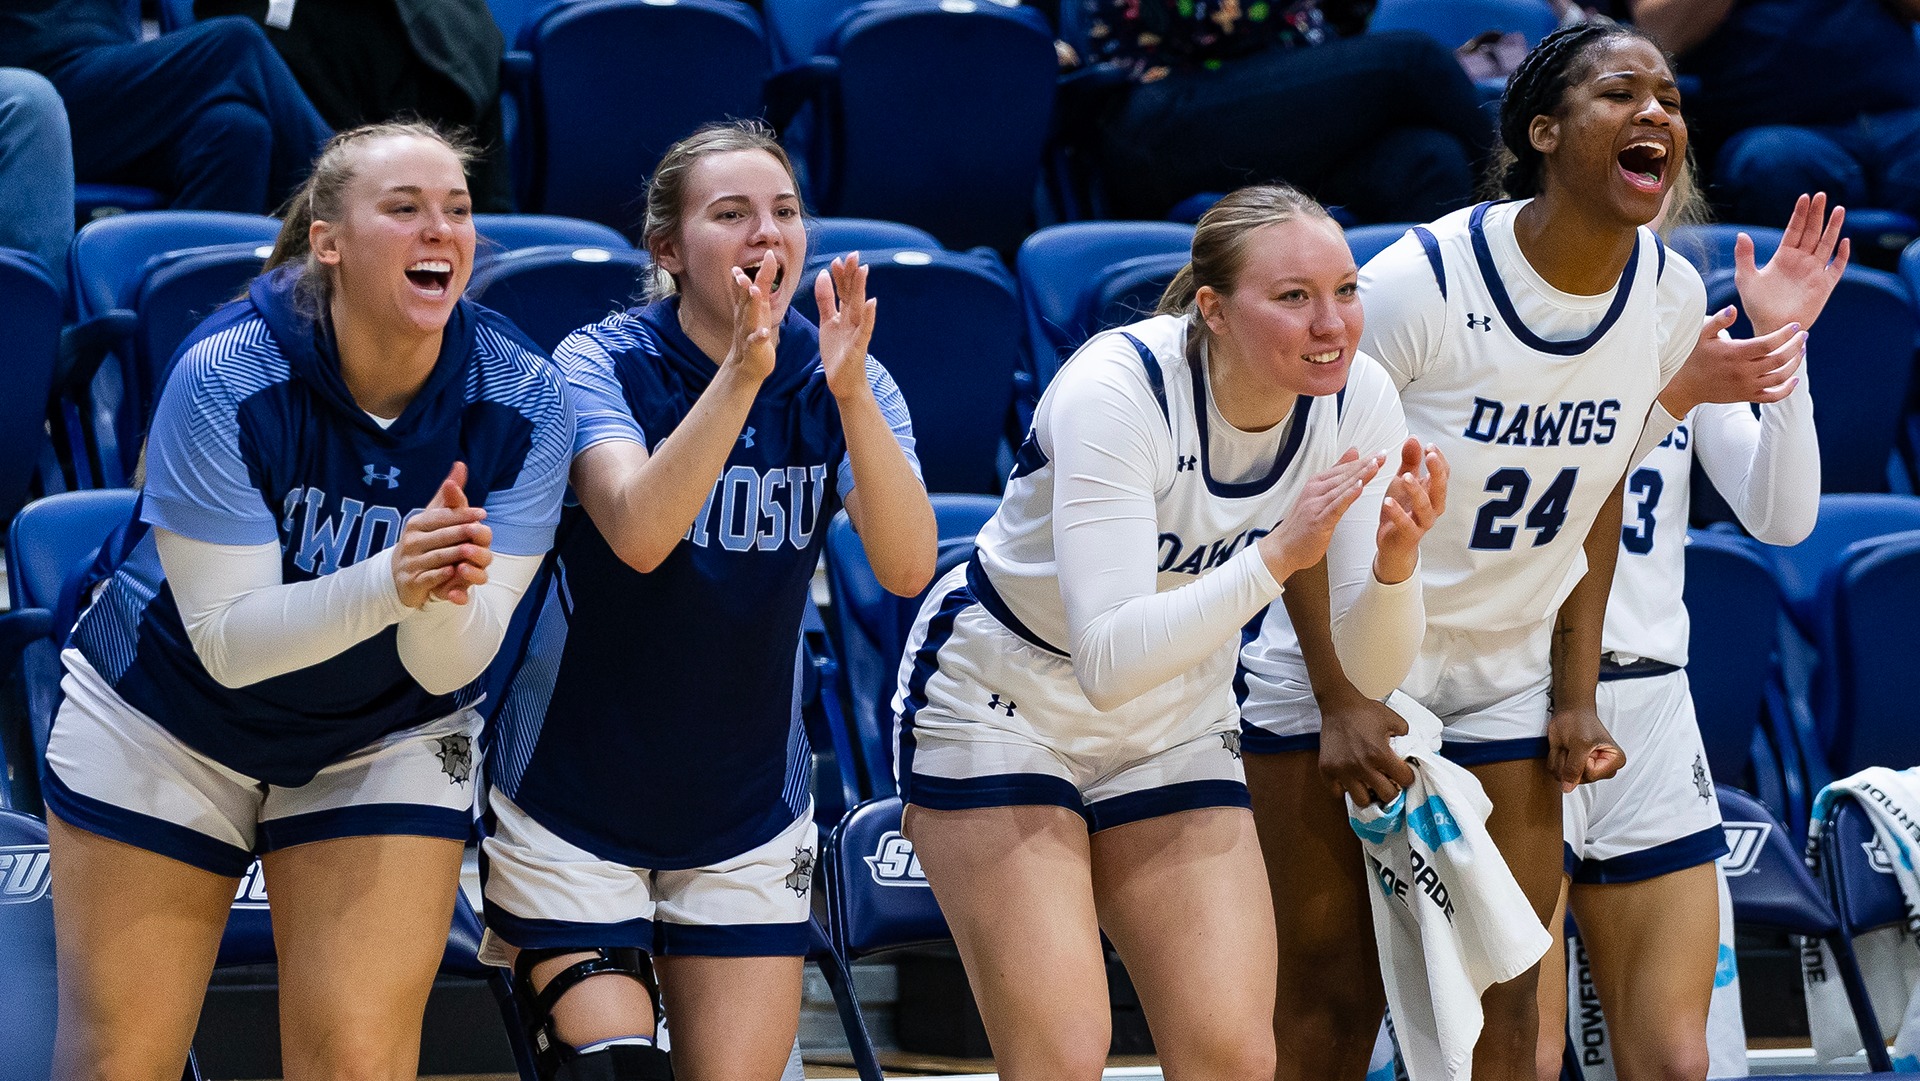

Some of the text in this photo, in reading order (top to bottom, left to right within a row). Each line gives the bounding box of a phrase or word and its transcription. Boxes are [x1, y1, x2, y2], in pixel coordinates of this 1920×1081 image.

[1463, 396, 1622, 447] DAWGS
[683, 463, 828, 552] OSU
[1468, 466, 1581, 551] 24
